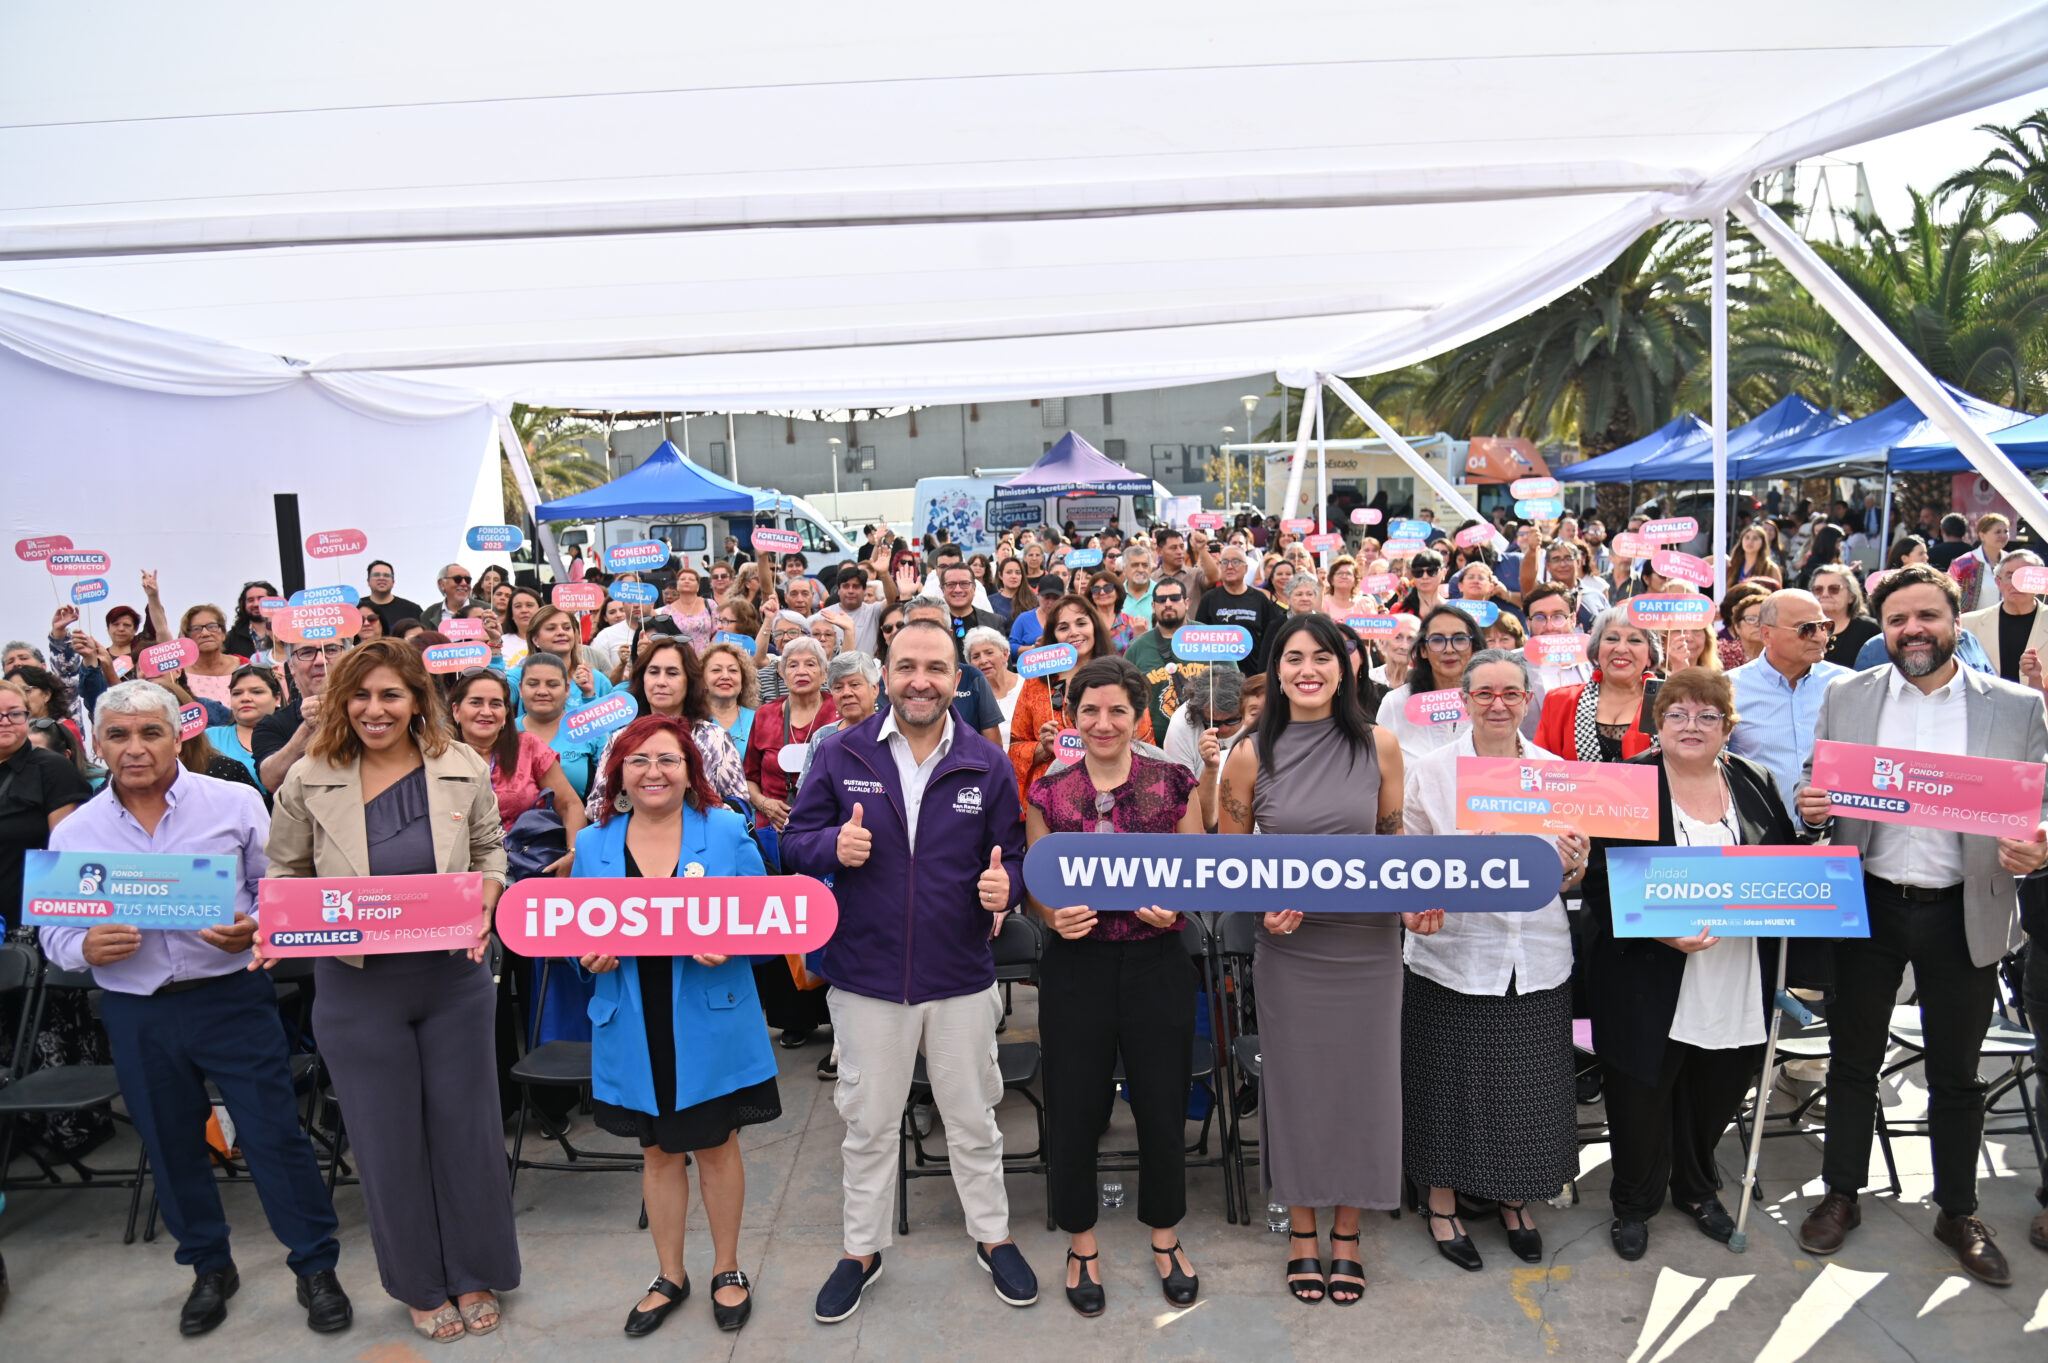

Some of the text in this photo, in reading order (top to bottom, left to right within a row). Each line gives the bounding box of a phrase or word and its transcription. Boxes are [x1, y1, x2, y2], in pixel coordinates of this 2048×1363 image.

[1468, 456, 1487, 469] 04
[997, 486, 1035, 497] Ministerio
[1107, 482, 1115, 490] de
[1117, 481, 1152, 491] Gobierno
[1646, 522, 1692, 532] FORTALECE
[757, 532, 798, 543] FORTALECE
[313, 542, 361, 555] ¡POSTULA!
[614, 545, 658, 558] FOMENTA
[52, 555, 104, 563] FORTALECE
[609, 554, 665, 568] TUS MEDIOS
[1660, 564, 1708, 584] ¡POSTULA!
[304, 587, 342, 599] FONDOS
[293, 606, 341, 618] FONDOS
[1639, 601, 1704, 612] PARTICIPA
[291, 616, 345, 628] SEGEGOB
[1638, 612, 1703, 621] CON LA NIÑEZ
[1350, 619, 1392, 627] PARTICIPA
[305, 627, 333, 637] 2025
[1185, 633, 1239, 642] FOMENTA
[149, 642, 181, 656] FONDOS
[431, 647, 482, 659] PARTICIPA
[1178, 644, 1246, 653] TUS MEDIOS
[149, 649, 186, 665] SEGEGOB
[1025, 648, 1066, 664] FOMENTA
[160, 660, 179, 670] 2025
[431, 659, 448, 667] CON
[449, 658, 458, 666] LA
[1021, 657, 1073, 673] TUS MEDIOS
[1422, 692, 1460, 703] FONDO
[570, 698, 624, 727] FOMENTA
[1420, 701, 1465, 712] SEGEGO
[1433, 710, 1458, 721] 2025
[567, 706, 634, 740] TUS MEDIOS
[1059, 748, 1074, 758] TUS
[1909, 768, 1944, 777] FONDOS
[1545, 782, 1577, 792] FFOIP
[1907, 780, 1953, 796] FFOIP
[1471, 798, 1649, 819] PARTICIPA CON LA NIÑEZ
[1912, 802, 1938, 816] TUS
[1943, 806, 2028, 827] PROYECTOS
[1058, 856, 1530, 889] WWW.FONDOS.GOB.CL
[1644, 867, 1688, 879] Unidad
[111, 883, 168, 896] MEDIOS
[1645, 882, 1831, 900] FONDOS SEGEGOB
[357, 894, 392, 902] FONDOS
[33, 900, 221, 917] FOMENTA TUS MENSAJES
[358, 907, 402, 920] FFOIP
[525, 895, 808, 937] ¡POSTULA!
[275, 924, 473, 944] FORTALECE TUS PROYECTOS
